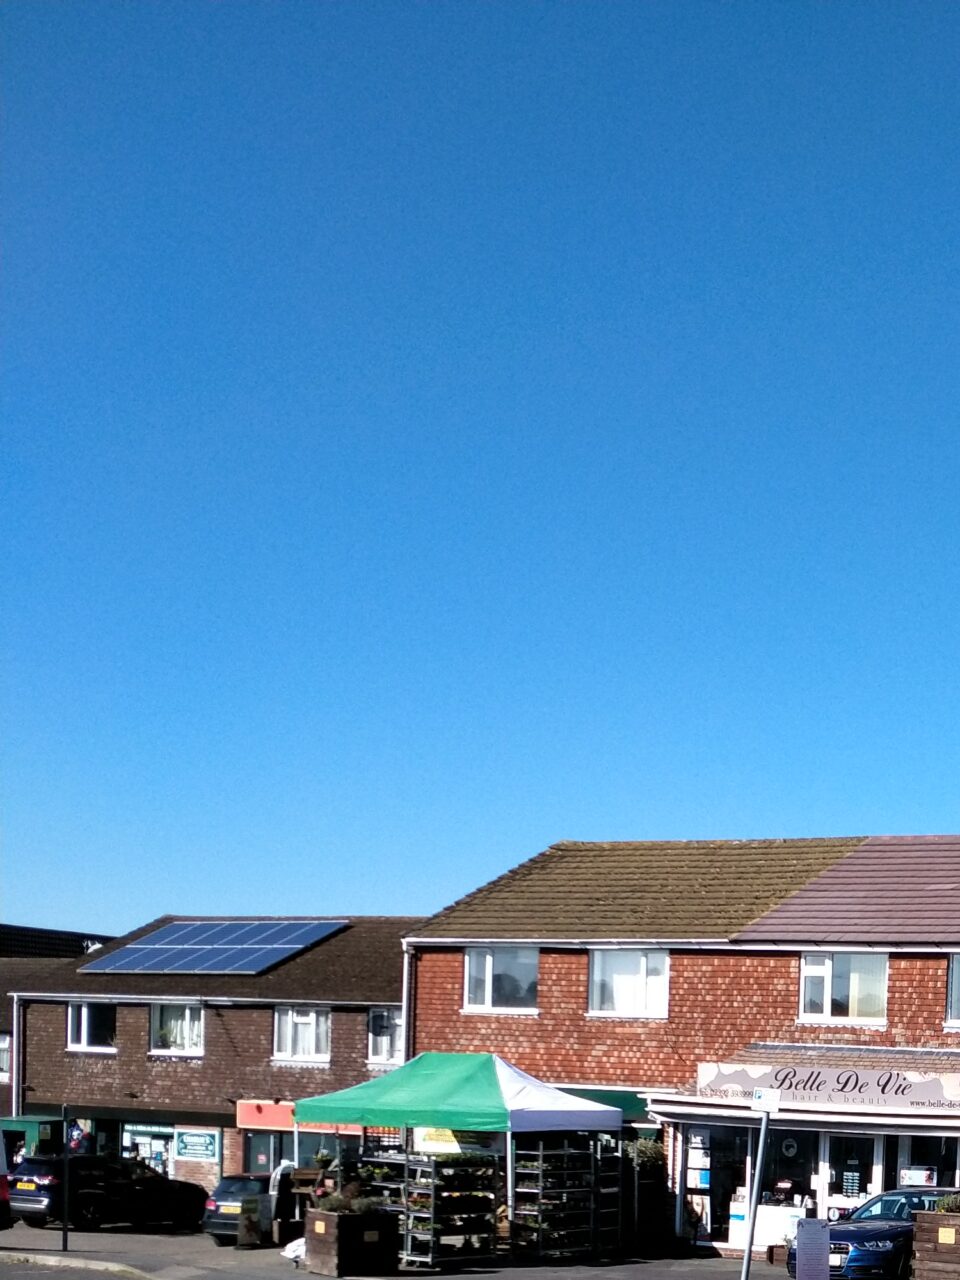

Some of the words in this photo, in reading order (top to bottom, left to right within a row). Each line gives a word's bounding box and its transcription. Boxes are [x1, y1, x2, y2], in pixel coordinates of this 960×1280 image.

[770, 1067, 827, 1092] Belle
[832, 1069, 869, 1094] De
[876, 1071, 913, 1096] Vie
[792, 1091, 818, 1101] hair
[826, 1093, 834, 1102] &
[843, 1094, 888, 1105] beauty
